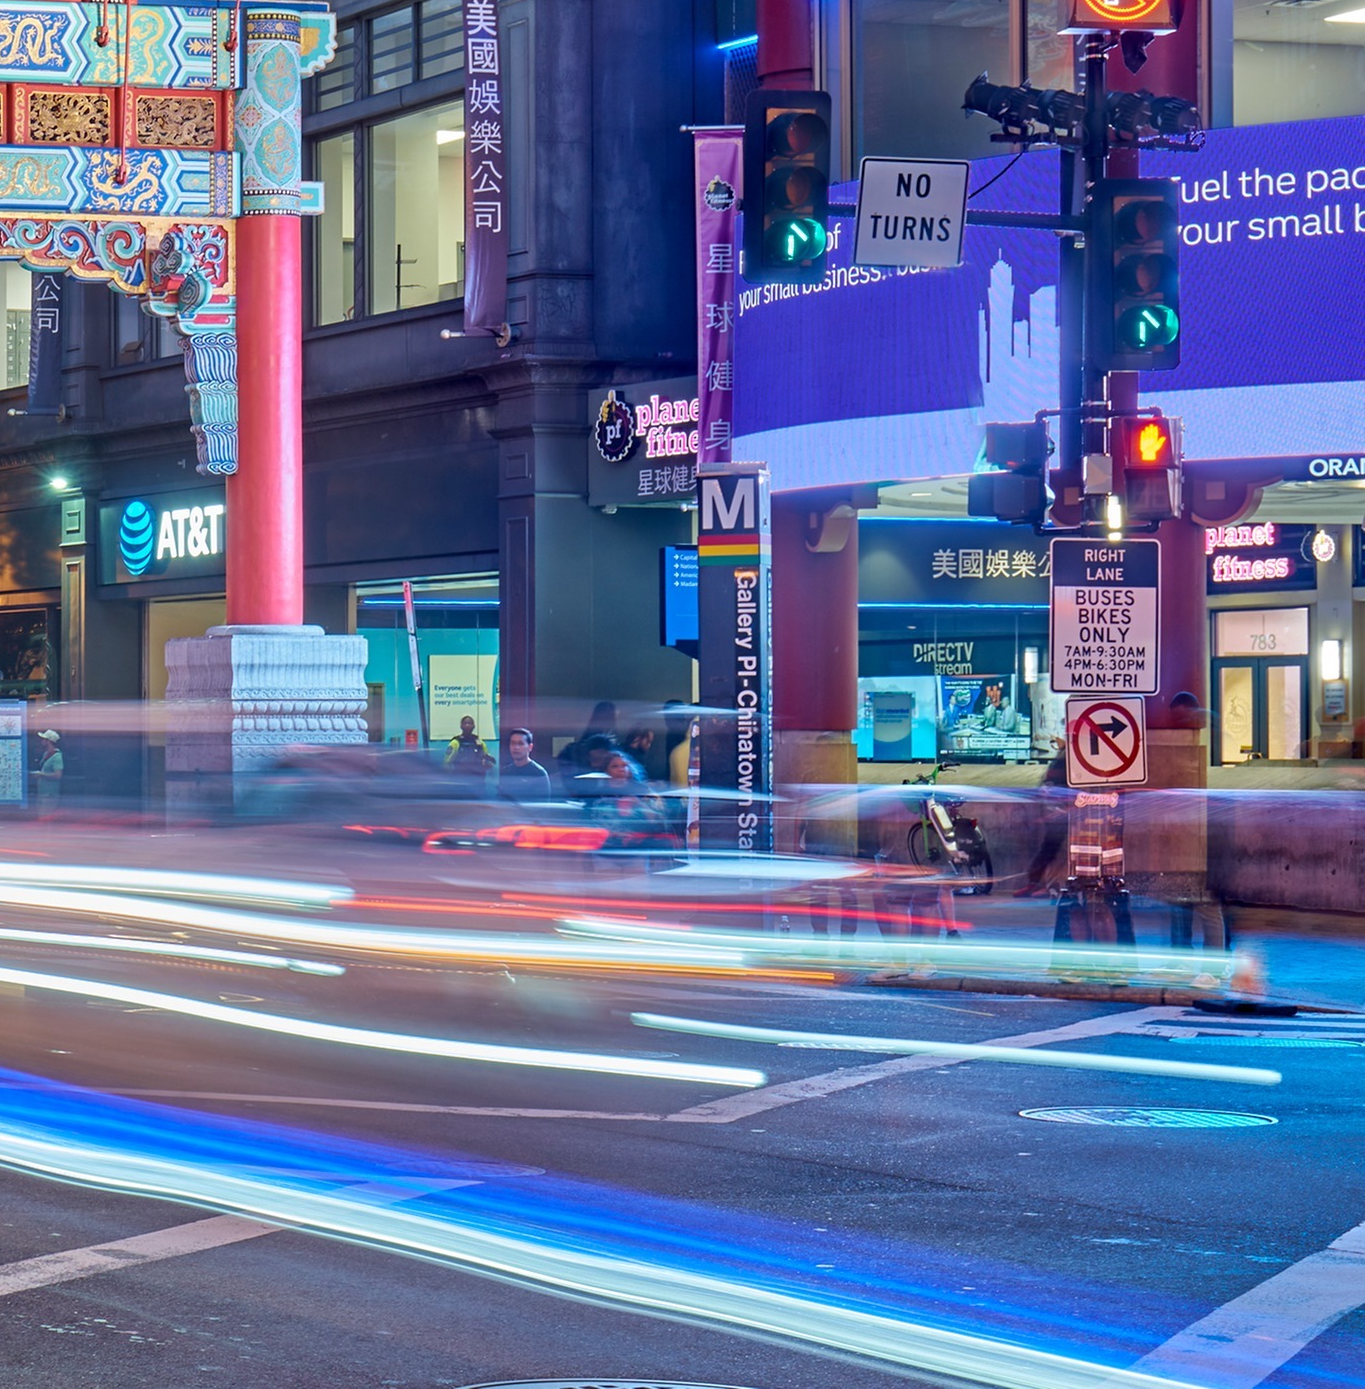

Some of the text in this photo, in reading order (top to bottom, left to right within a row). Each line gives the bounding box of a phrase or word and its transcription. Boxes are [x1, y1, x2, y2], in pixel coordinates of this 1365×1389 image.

[466, 0, 503, 234] 美國娛樂公司
[896, 173, 932, 199] NO
[1171, 167, 1231, 204] uel
[1238, 167, 1297, 198] the
[870, 213, 952, 242] TURNS
[1177, 220, 1240, 247] our
[1247, 203, 1345, 242] small
[35, 274, 61, 333] 公司
[739, 286, 762, 317] your
[705, 243, 733, 451] 星球健身
[606, 418, 623, 446] pf
[701, 477, 755, 530] M
[156, 504, 226, 561] AT&T
[1205, 520, 1275, 555] planet
[1084, 547, 1126, 563] RIGHT
[1086, 567, 1125, 582] LANE
[1213, 555, 1290, 582] fitness
[735, 571, 758, 650] Gallery
[1075, 589, 1135, 607] BUSES
[1078, 608, 1132, 625] BIKES
[1079, 626, 1130, 643] ONLY
[1250, 634, 1278, 651] 783
[913, 642, 974, 663] DIRECTV
[1064, 645, 1146, 658] 7AM-9:30AM
[934, 662, 973, 676] stream
[1064, 659, 1146, 671] 4PM-6:30PM
[1070, 673, 1139, 689] MON-FRI
[452, 699, 487, 707] smartphone
